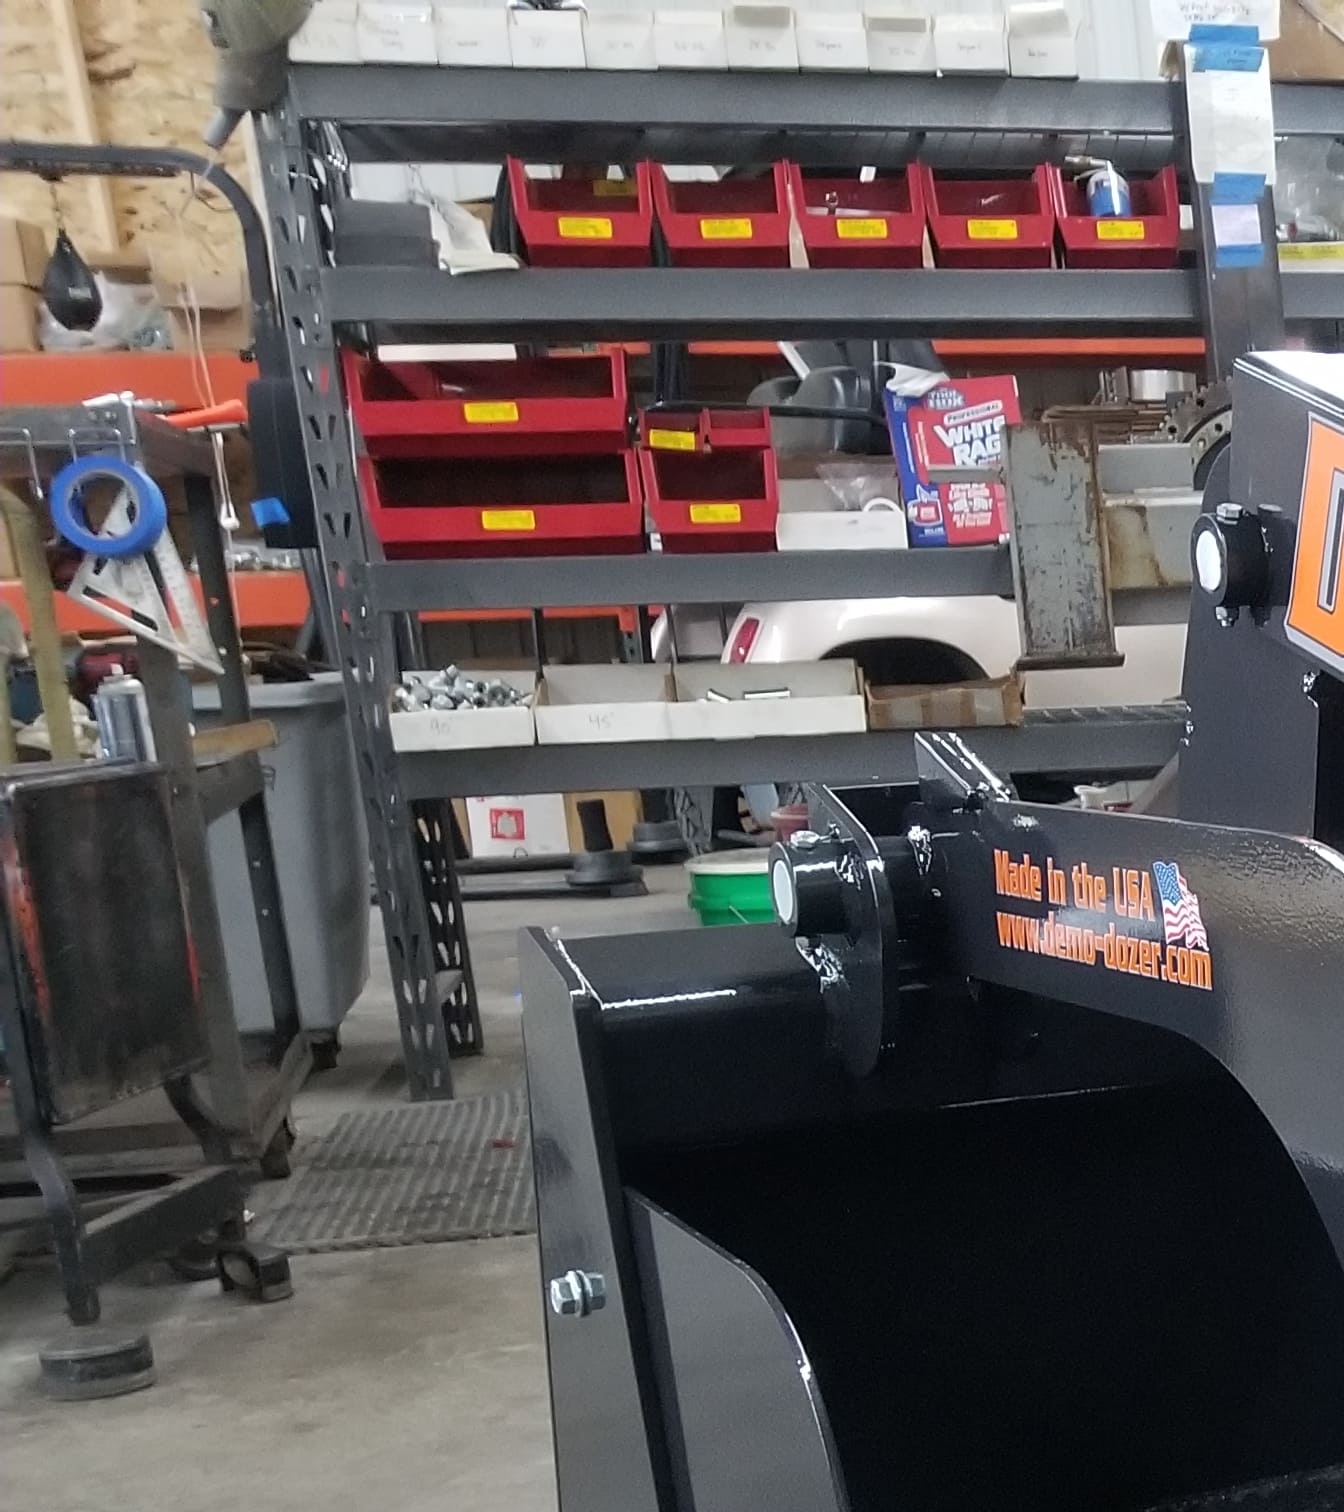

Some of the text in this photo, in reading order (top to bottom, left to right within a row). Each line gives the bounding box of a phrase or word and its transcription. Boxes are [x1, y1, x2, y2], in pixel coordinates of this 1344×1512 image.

[947, 403, 1000, 422] PROFESSIONAL
[994, 849, 1156, 922] Made in the USA
[995, 910, 1213, 991] www.demo-dozer.com
